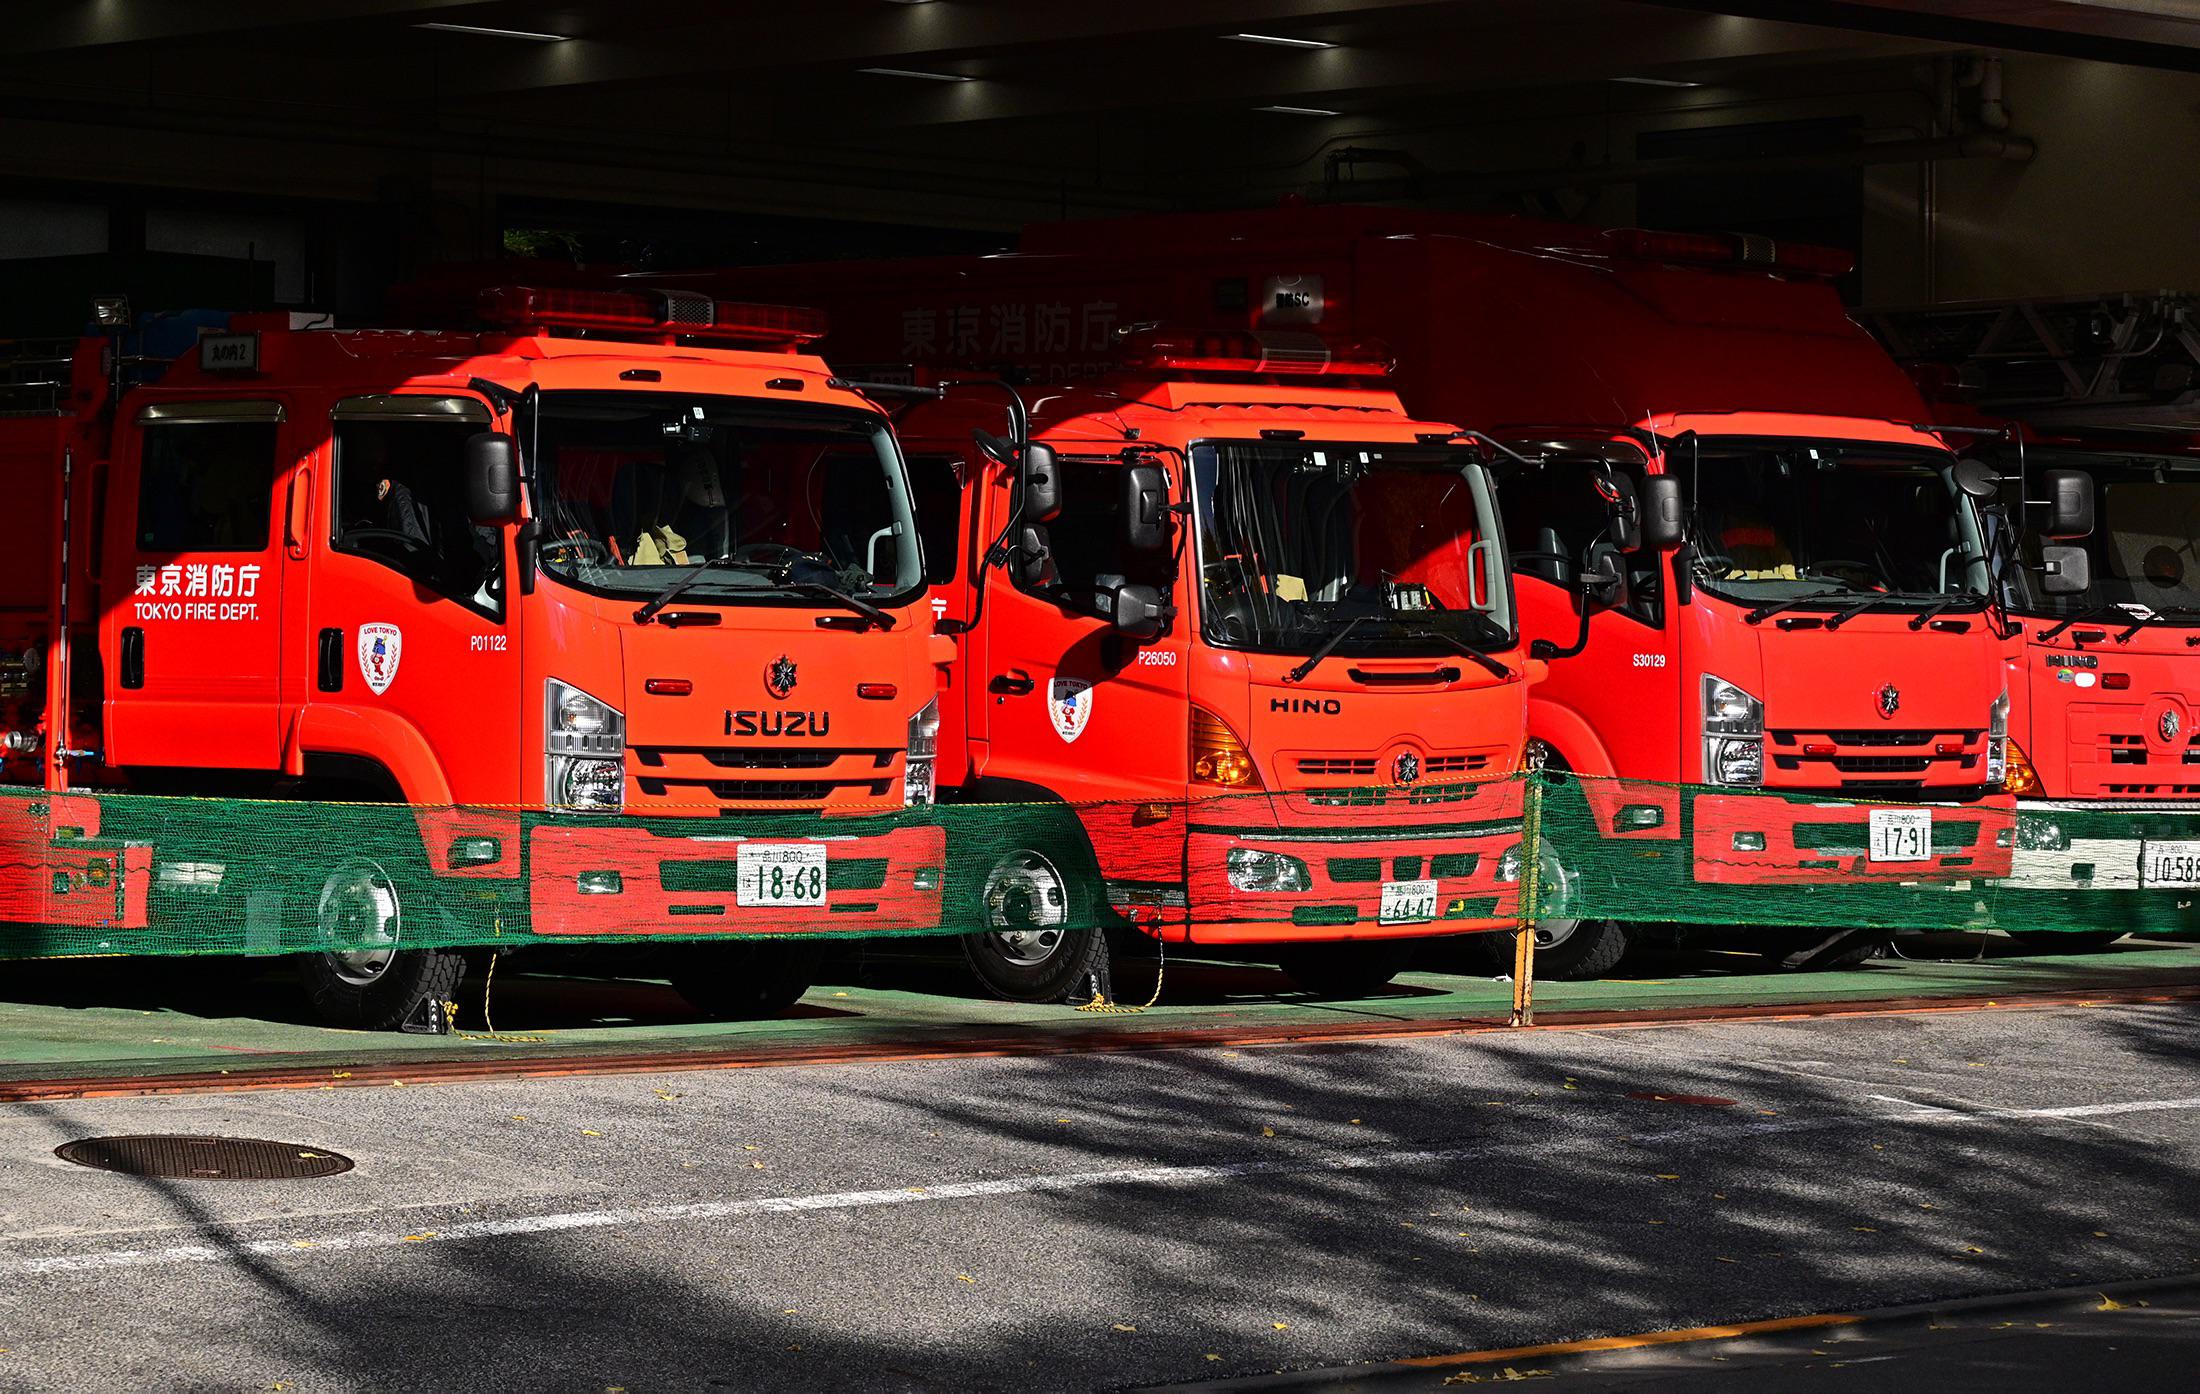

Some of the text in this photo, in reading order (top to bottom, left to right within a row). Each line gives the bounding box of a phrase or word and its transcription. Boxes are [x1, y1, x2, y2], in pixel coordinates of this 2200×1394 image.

[901, 298, 1119, 357] 東京消防庁
[134, 563, 261, 597] 東京消防庁
[134, 603, 259, 620] TOKYO FIRE DEPT.
[363, 627, 398, 636] LOVE TOKYO
[470, 635, 507, 651] P01122
[1138, 651, 1177, 666] P26050
[1632, 653, 1666, 667] S30129
[1270, 698, 1341, 715] HINO
[723, 709, 830, 737] ISUZU
